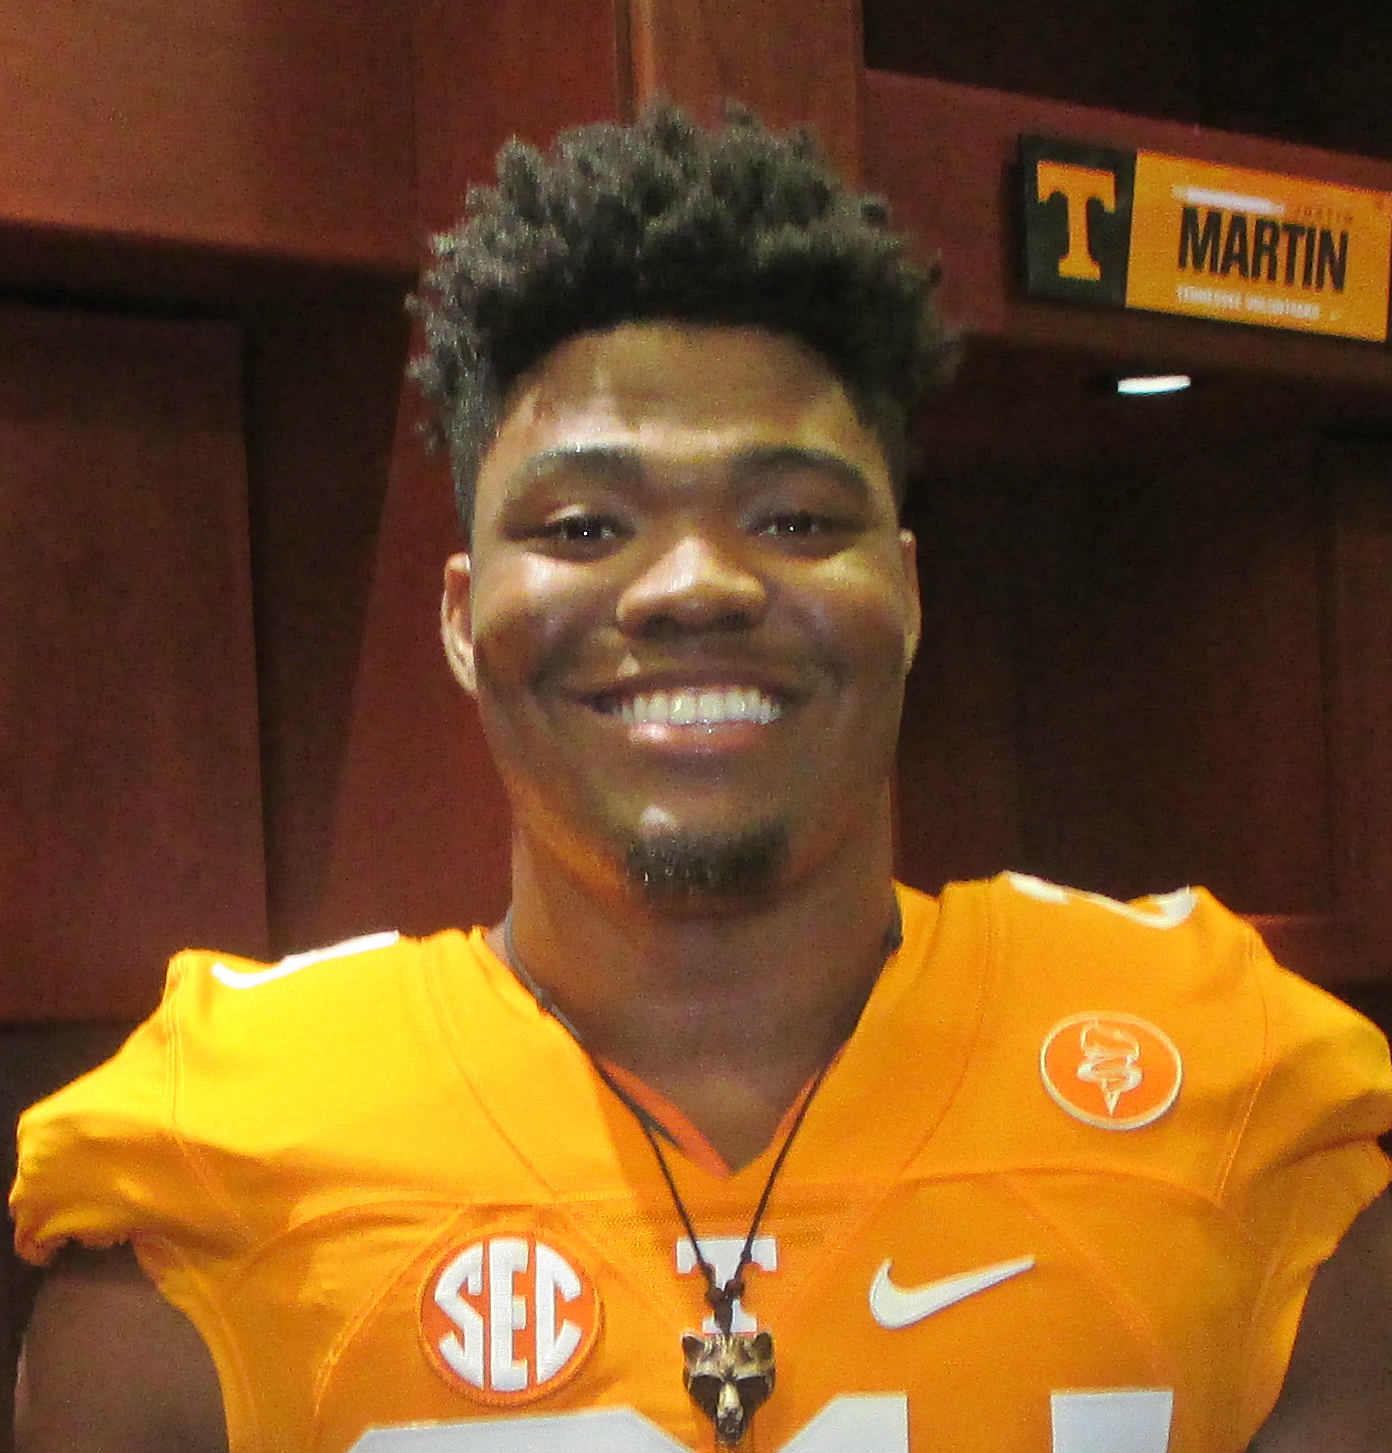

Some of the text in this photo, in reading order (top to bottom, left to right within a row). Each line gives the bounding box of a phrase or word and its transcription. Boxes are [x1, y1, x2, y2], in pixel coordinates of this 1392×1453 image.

[1037, 160, 1116, 281] T
[1178, 206, 1349, 293] MARTIN
[433, 1236, 583, 1393] SEC
